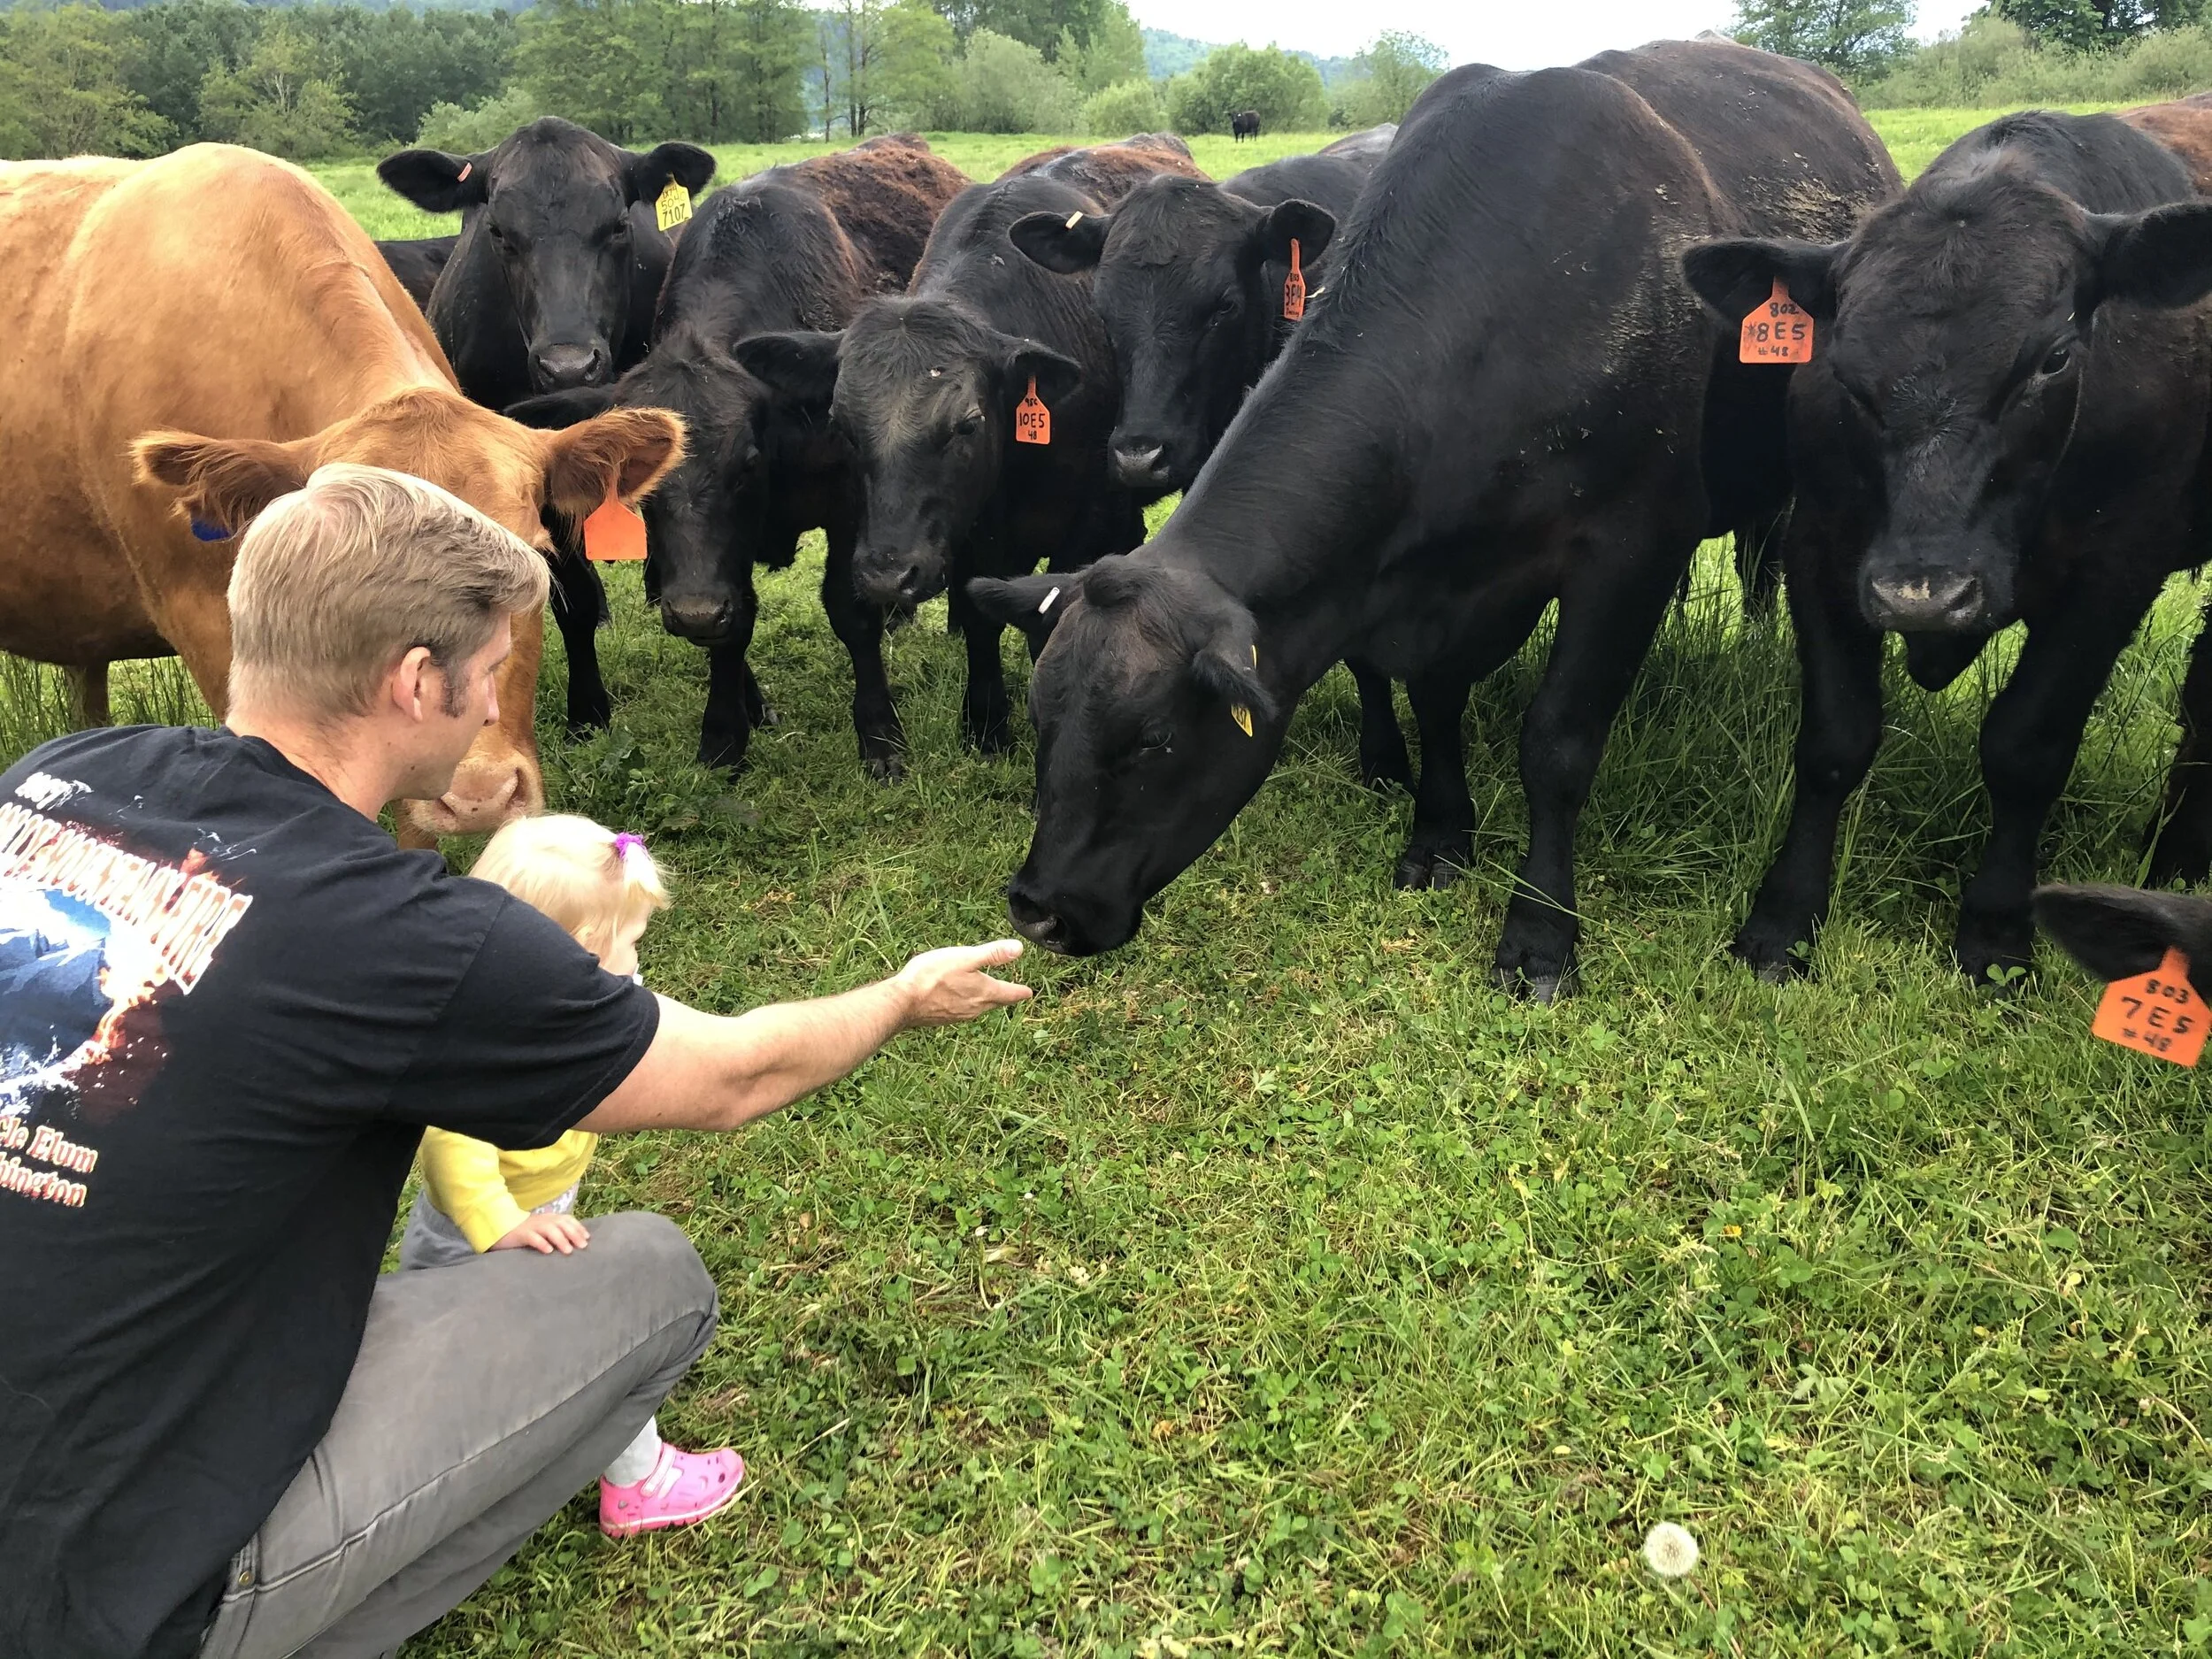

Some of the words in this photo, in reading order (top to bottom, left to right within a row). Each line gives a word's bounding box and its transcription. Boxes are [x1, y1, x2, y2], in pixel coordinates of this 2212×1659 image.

[662, 203, 686, 227] 7107
[1770, 302, 1800, 318] 802
[1019, 411, 1046, 428] 10E5
[1027, 430, 1037, 441] 48
[147, 872, 254, 995] FIRE
[2147, 979, 2189, 1004] 803
[26, 1125, 98, 1173] Elum
